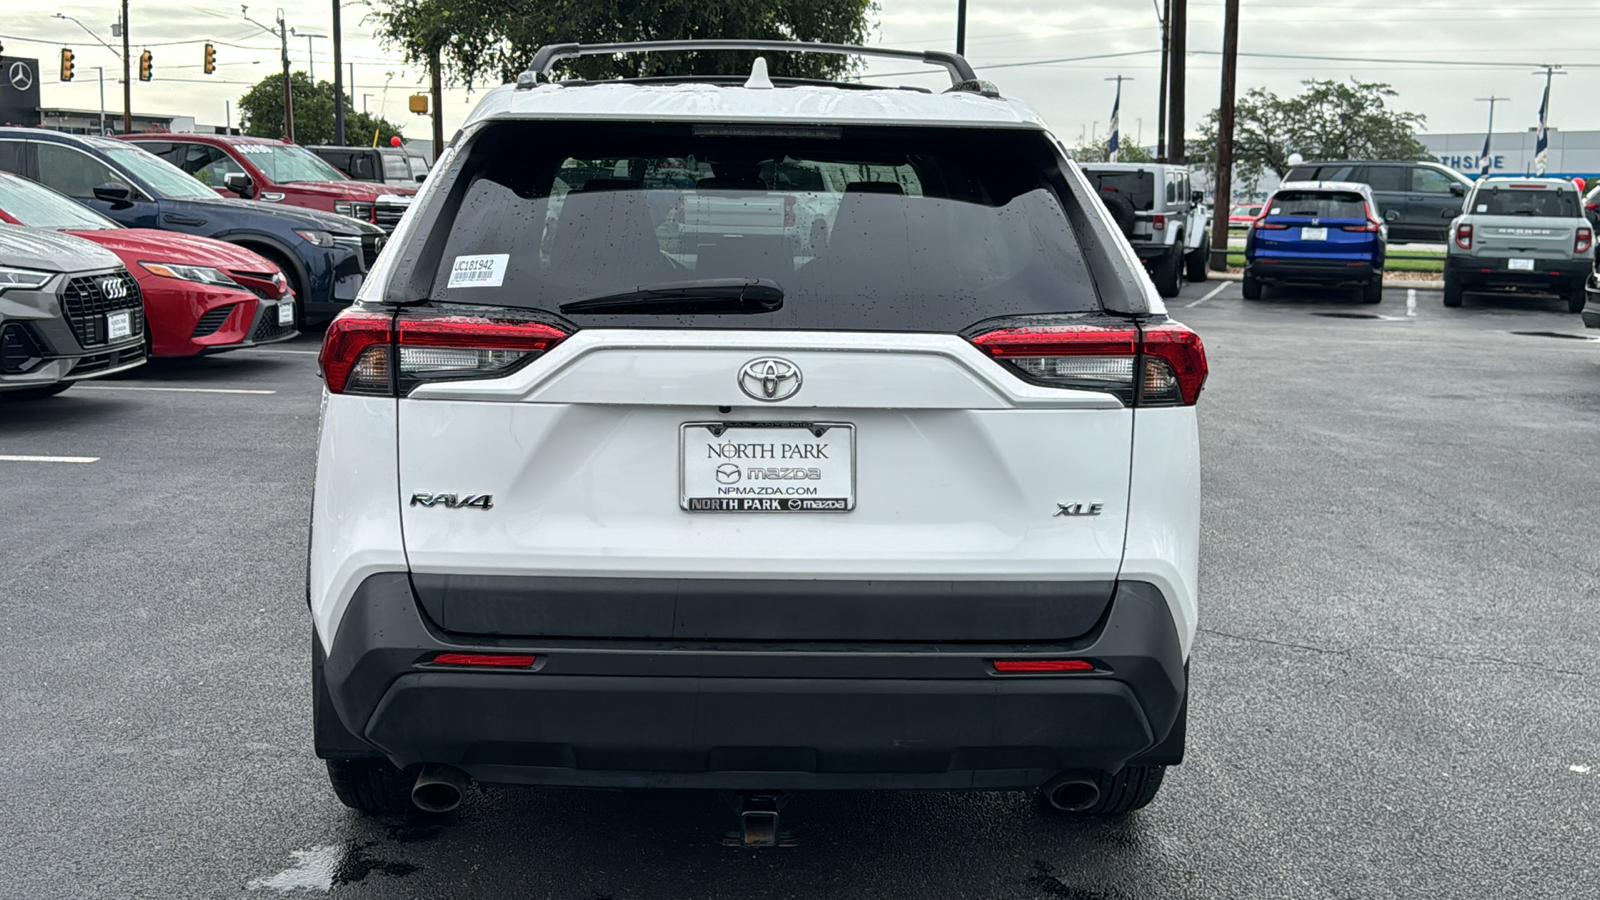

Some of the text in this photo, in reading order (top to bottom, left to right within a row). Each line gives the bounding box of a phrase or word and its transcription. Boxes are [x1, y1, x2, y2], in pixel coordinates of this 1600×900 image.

[707, 442, 829, 460] NORTH PARK
[747, 467, 821, 480] mazda
[717, 486, 818, 496] NPMAZDA.COM
[409, 490, 494, 511] RAV4
[692, 499, 738, 510] NORTH
[743, 499, 782, 510] PARK
[1052, 501, 1104, 517] XLE
